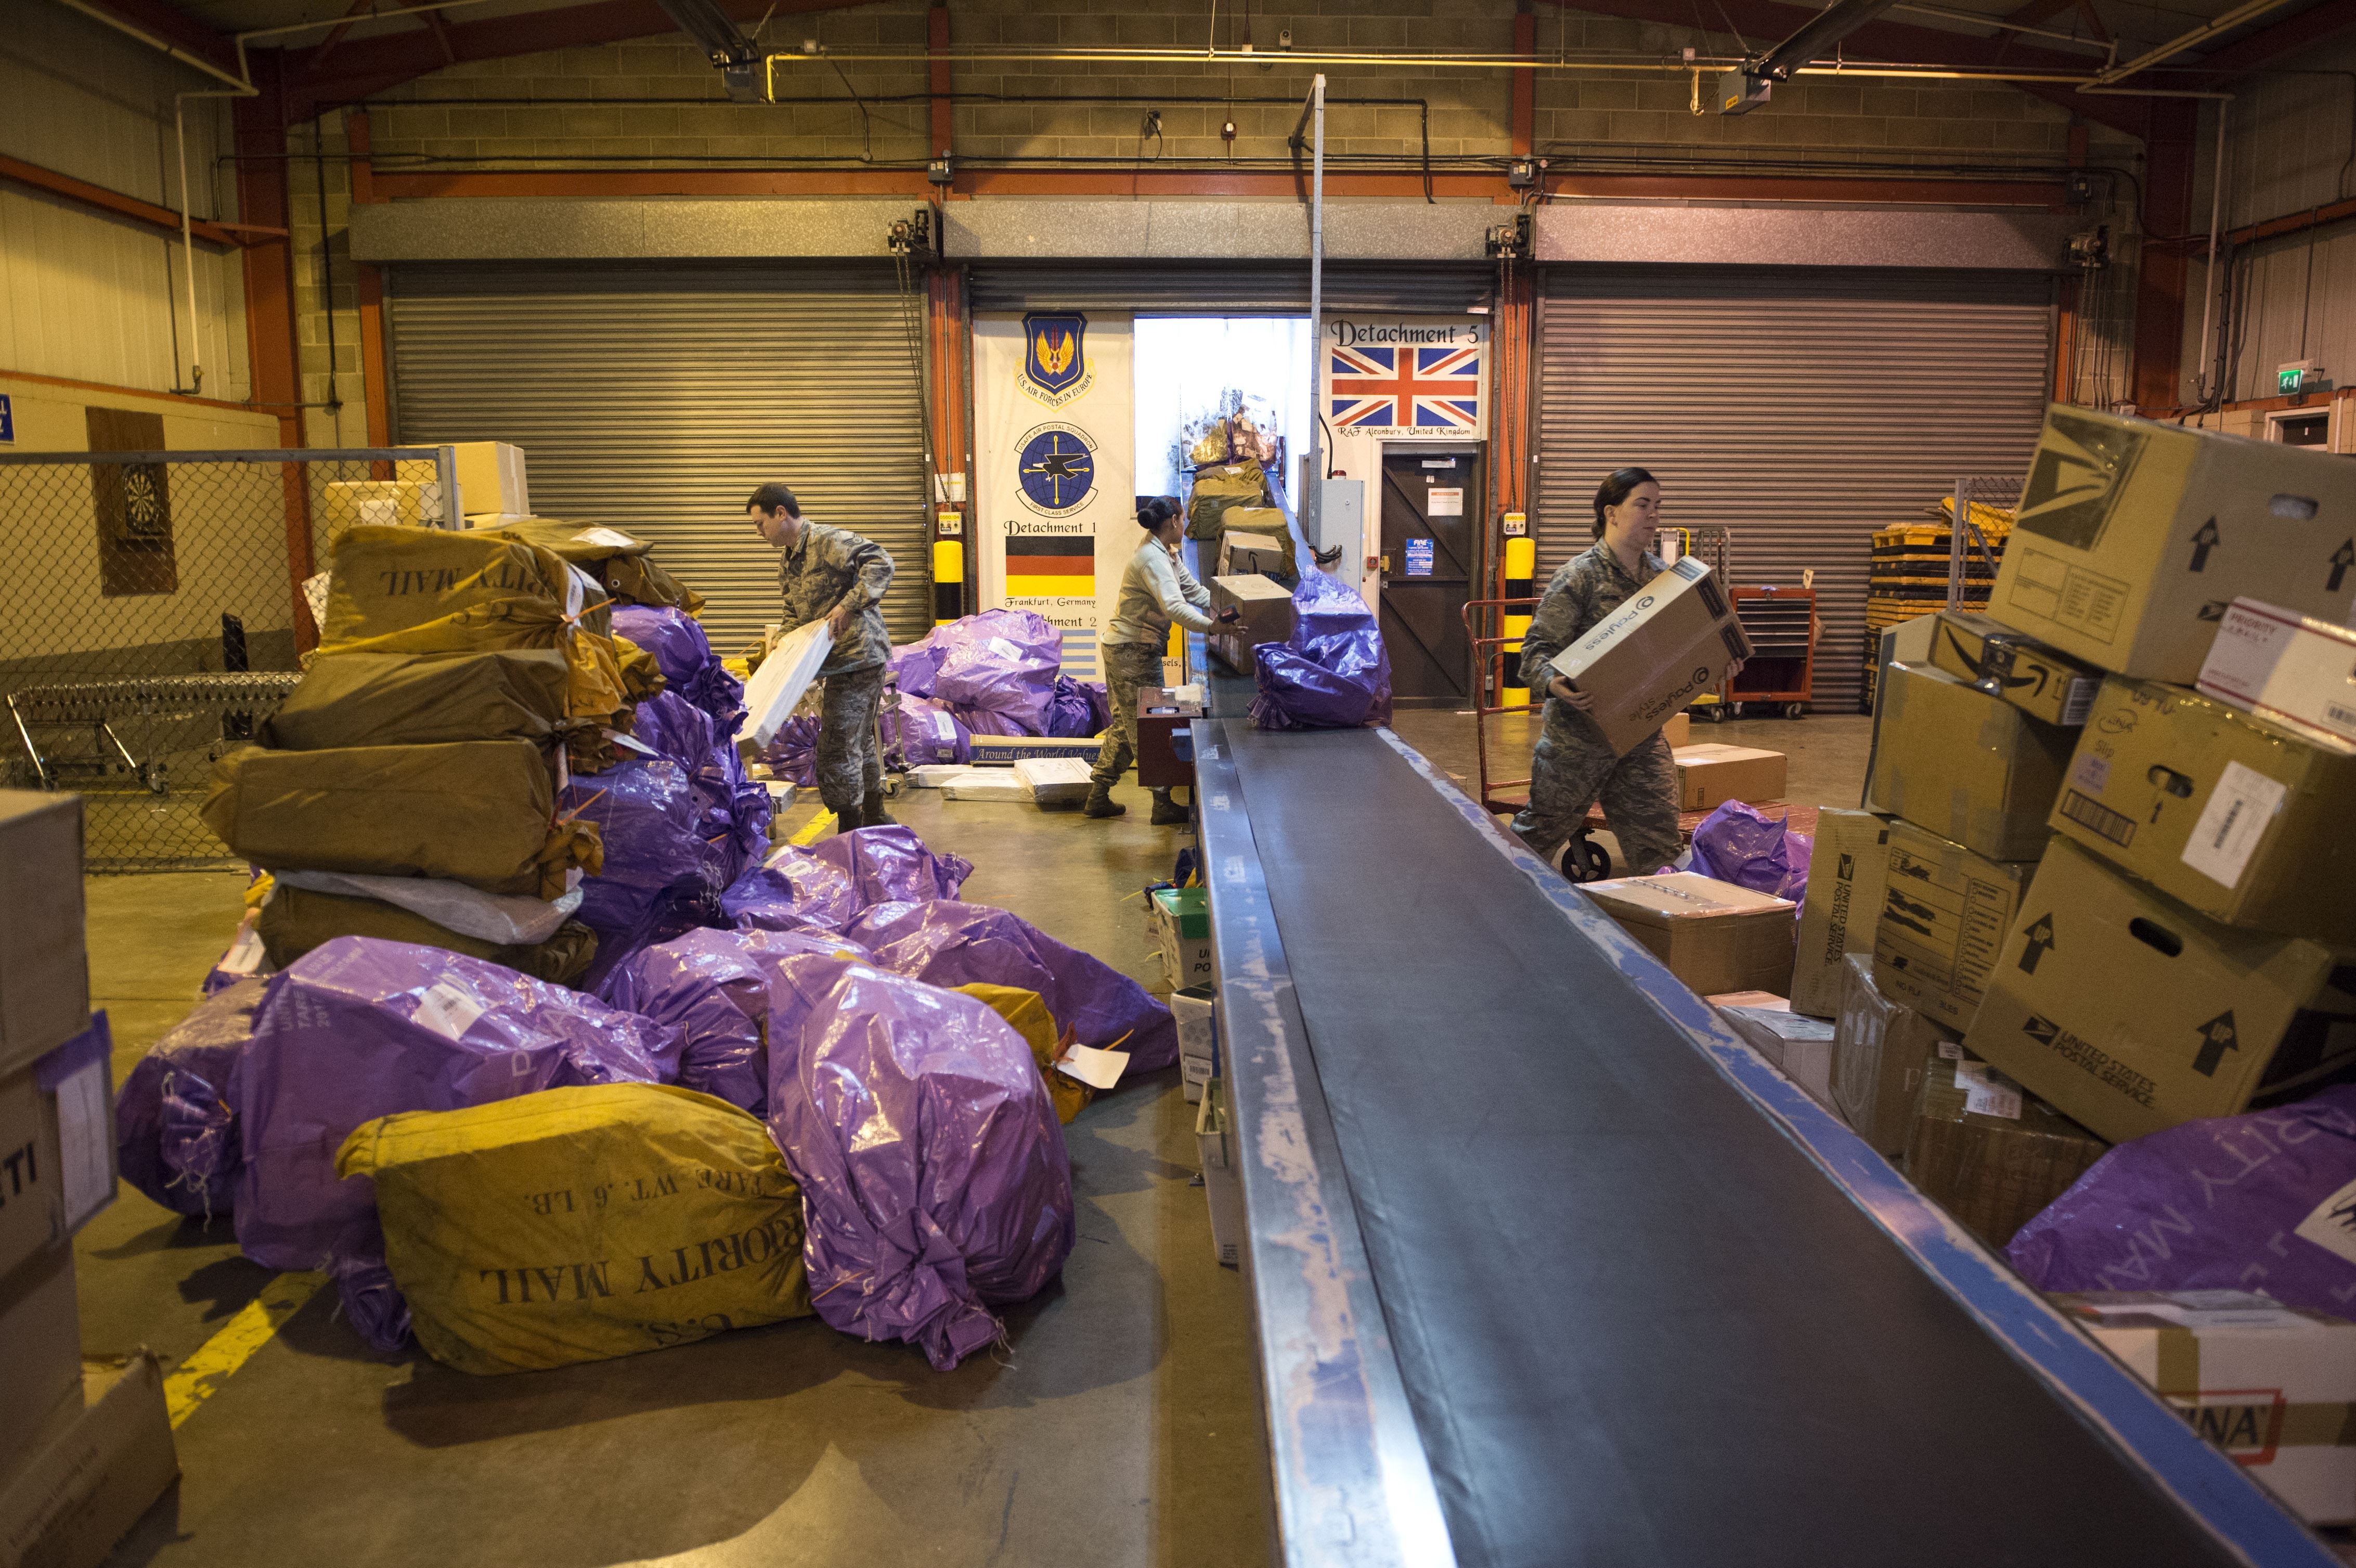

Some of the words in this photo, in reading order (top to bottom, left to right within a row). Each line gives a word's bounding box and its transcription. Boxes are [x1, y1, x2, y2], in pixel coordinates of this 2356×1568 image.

[1330, 319, 1456, 346] Detachment
[1468, 325, 1479, 344] 5
[1017, 373, 1027, 390] U.S.
[1026, 385, 1039, 397] AIR
[1040, 392, 1063, 407] FORCES
[1064, 391, 1071, 402] IN
[1072, 372, 1094, 397] EUROPE
[1018, 434, 1032, 450] USAFE
[1033, 427, 1042, 435] AIR
[1066, 426, 1094, 449] SQUADRON
[1338, 427, 1361, 437] RAF
[1365, 427, 1404, 437] Alconbury,
[1407, 427, 1433, 435] United
[1437, 427, 1470, 437] Kingdom
[1029, 502, 1043, 513] FIRST
[1063, 501, 1084, 515] SERVICE
[1003, 520, 1083, 536] Detachment
[380, 567, 461, 597] MAIL
[1004, 598, 1053, 607] Frankfurt,
[1057, 598, 1096, 608] Germany
[1043, 615, 1083, 627] hment
[1090, 617, 1097, 627] 2
[1585, 610, 1639, 651] Payless
[1163, 658, 1181, 668] sels,
[1645, 683, 1695, 723] Payless
[976, 747, 1016, 760] Around
[1016, 748, 1031, 760] the
[1034, 748, 1066, 759] World
[1832, 881, 1844, 923] POSTAL
[1839, 884, 1852, 924] UNITED
[1833, 925, 1847, 963] STATES
[2054, 1041, 2098, 1075] POSTAL
[2061, 1030, 2111, 1065] UNITED
[2107, 1059, 2158, 1094] STATES
[633, 1212, 806, 1295] RIORITY
[478, 1260, 615, 1305] MAIL
